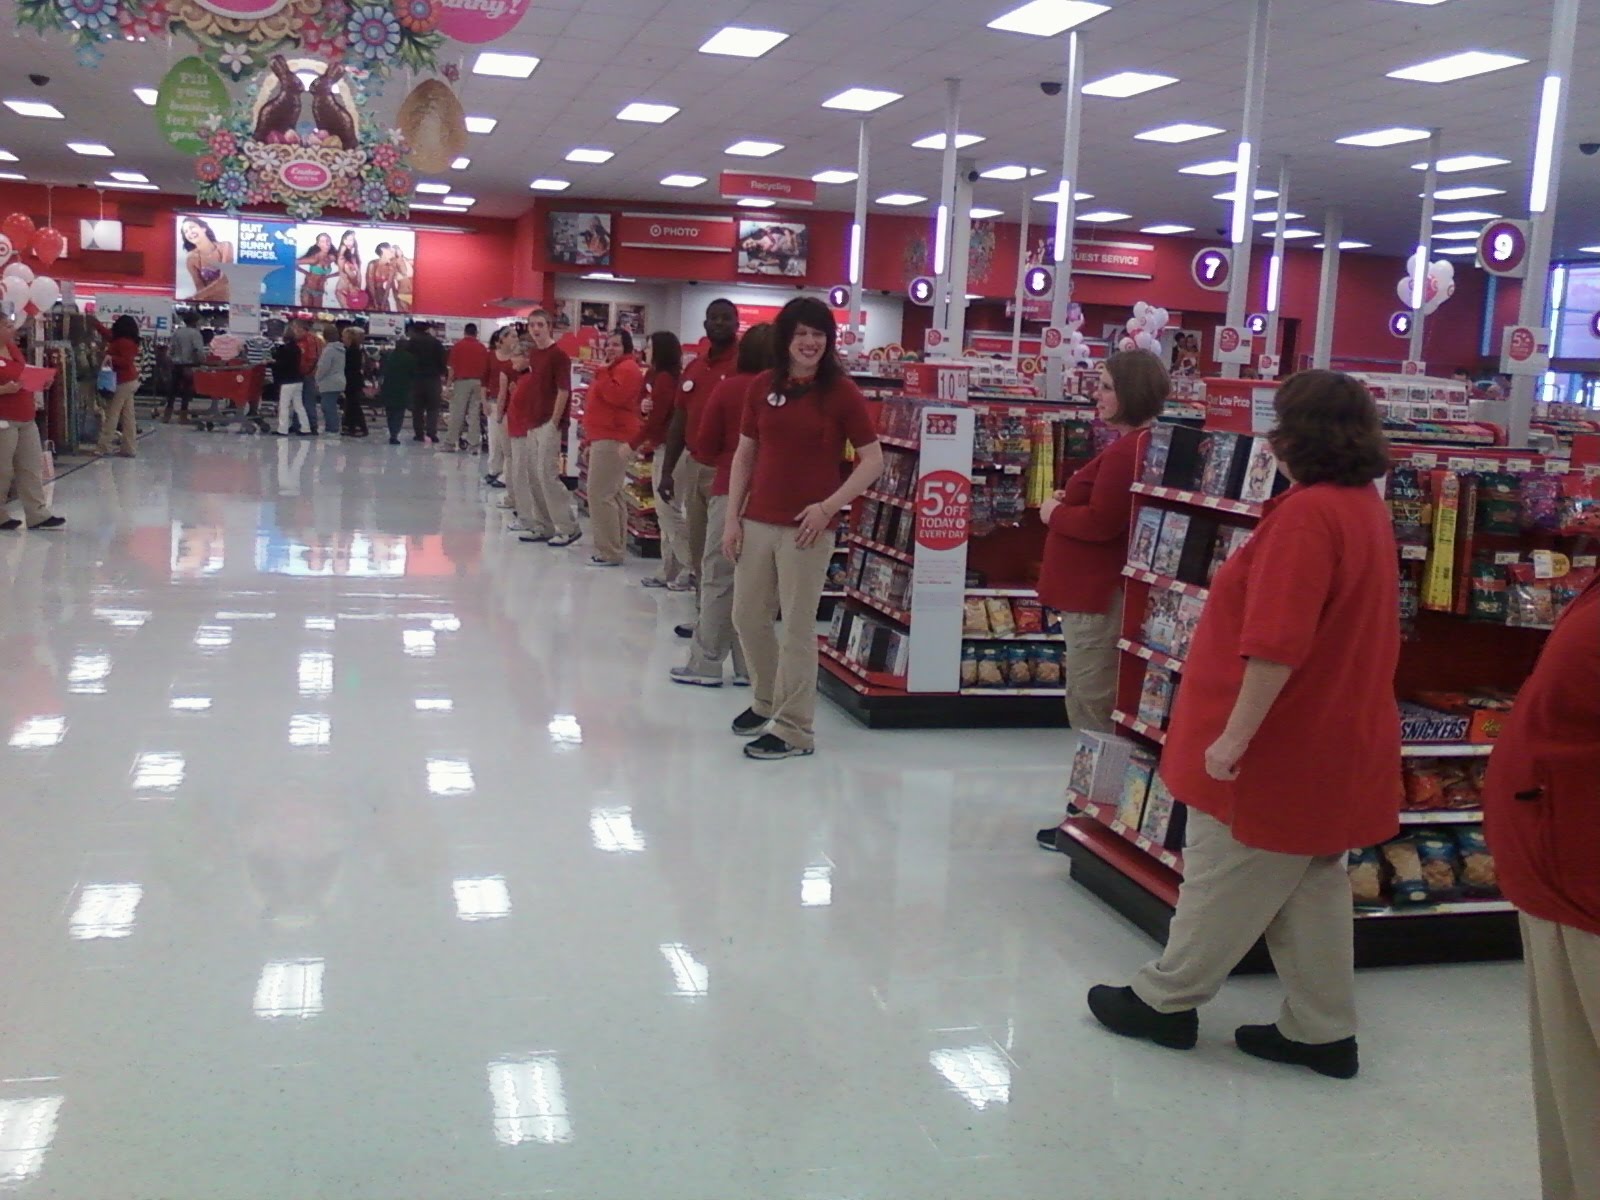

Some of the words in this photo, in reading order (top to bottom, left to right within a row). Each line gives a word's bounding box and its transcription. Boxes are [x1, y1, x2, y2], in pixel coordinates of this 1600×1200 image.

[751, 180, 781, 192] Recycling
[240, 223, 263, 233] SUIT
[663, 226, 699, 237] PHOTO
[240, 232, 255, 241] UP
[256, 233, 269, 242] AT
[240, 241, 275, 251] SUNNY
[1493, 233, 1513, 261] 9
[1073, 252, 1100, 263] UEST
[1101, 253, 1140, 266] SERVICE
[1205, 257, 1221, 279] 7
[916, 282, 929, 299] 3
[834, 290, 844, 305] 1
[124, 306, 146, 315] about
[112, 314, 168, 329] SYLE
[1252, 318, 1264, 331] 2
[1396, 317, 1407, 332] 4
[1219, 395, 1233, 407] Low
[1233, 395, 1251, 408] Price
[921, 480, 968, 516] 5%
[944, 505, 968, 517] OFF
[920, 517, 955, 529] TODAY
[919, 529, 946, 539] EVERY
[948, 530, 965, 540] DAY
[1401, 718, 1470, 740] SNICKERS
